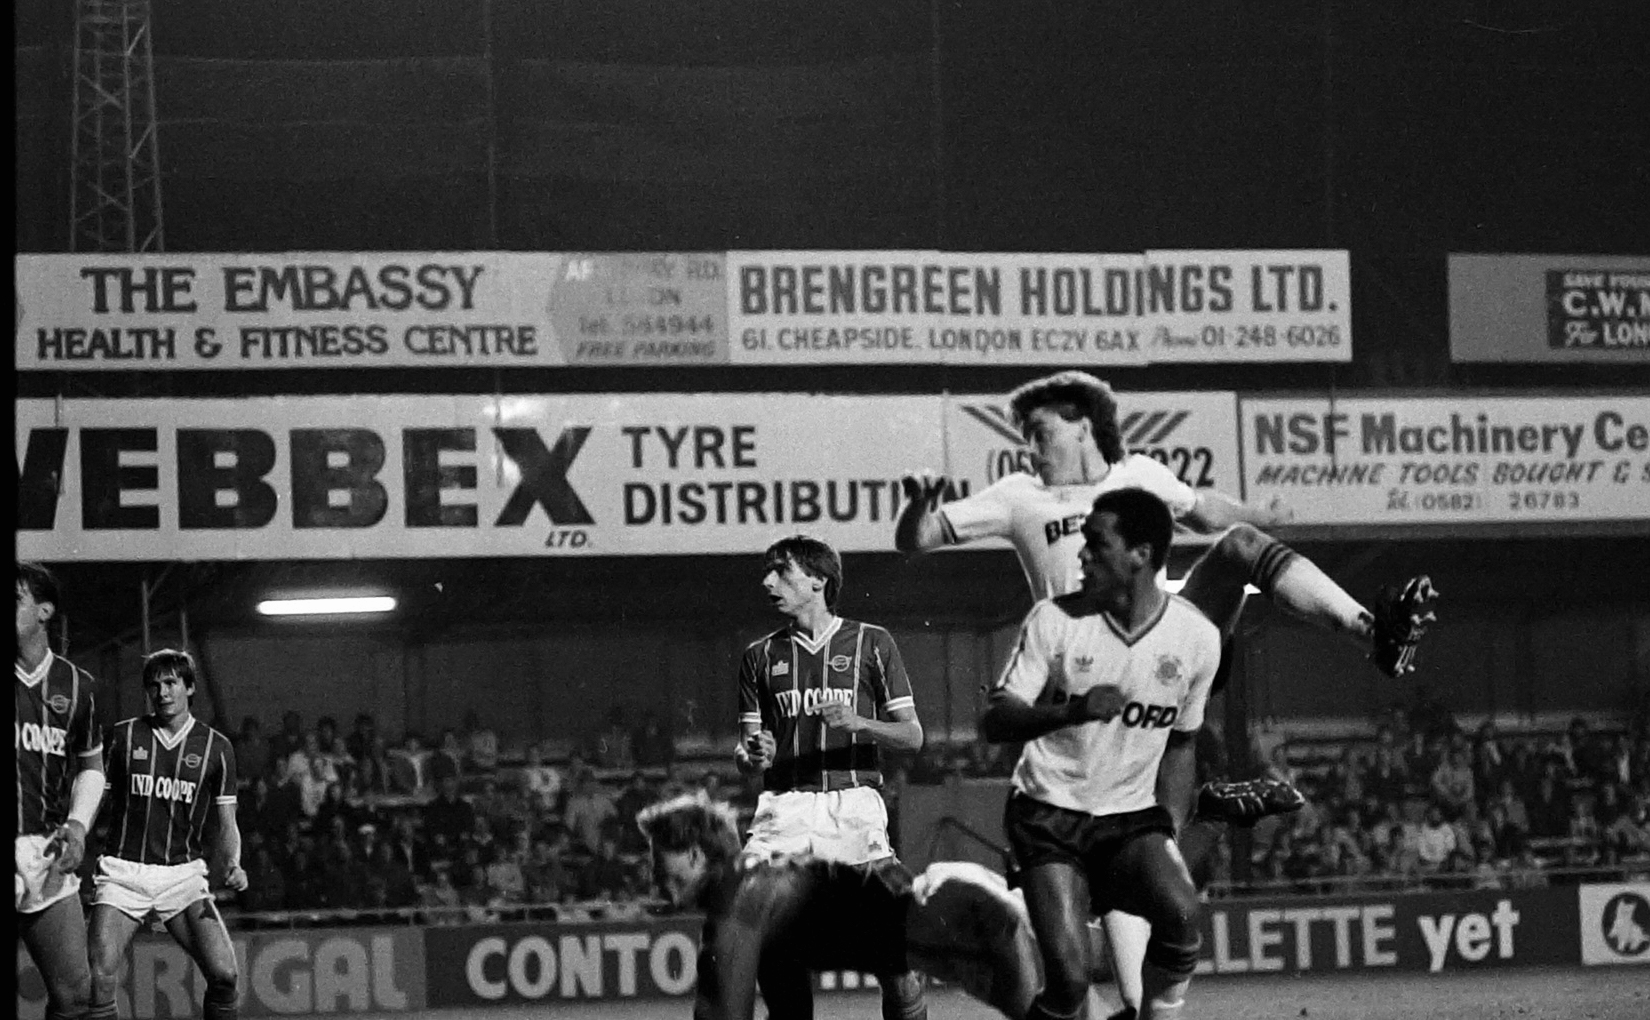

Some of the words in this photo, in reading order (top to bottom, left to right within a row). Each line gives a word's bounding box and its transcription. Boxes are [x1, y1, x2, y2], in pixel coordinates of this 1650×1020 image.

[80, 266, 197, 313] THE
[222, 264, 485, 312] EMBASSY
[740, 265, 1000, 316] BRENGREEN
[1019, 264, 1234, 317] HOLDINGS
[1251, 265, 1338, 312] LTD.
[37, 327, 176, 360] HEALTH
[195, 327, 222, 359] &
[240, 326, 389, 359] FITNESS
[404, 324, 538, 357] CENTRE
[928, 327, 1022, 354] LONDON
[1030, 328, 1088, 353] EC2V
[1234, 324, 1277, 348] 248
[1602, 321, 1650, 346] LON
[622, 426, 757, 469] TYRE
[1254, 412, 1349, 455] NSF
[1360, 411, 1585, 459] Machinery
[1254, 463, 1386, 486] MACHINE
[1399, 462, 1479, 486] TOOLS
[1491, 460, 1605, 486] BOUGHT
[624, 479, 970, 526] DISTRIBUTIN
[131, 773, 154, 797] IND
[155, 775, 196, 803] COOPE
[1417, 900, 1521, 973] yet
